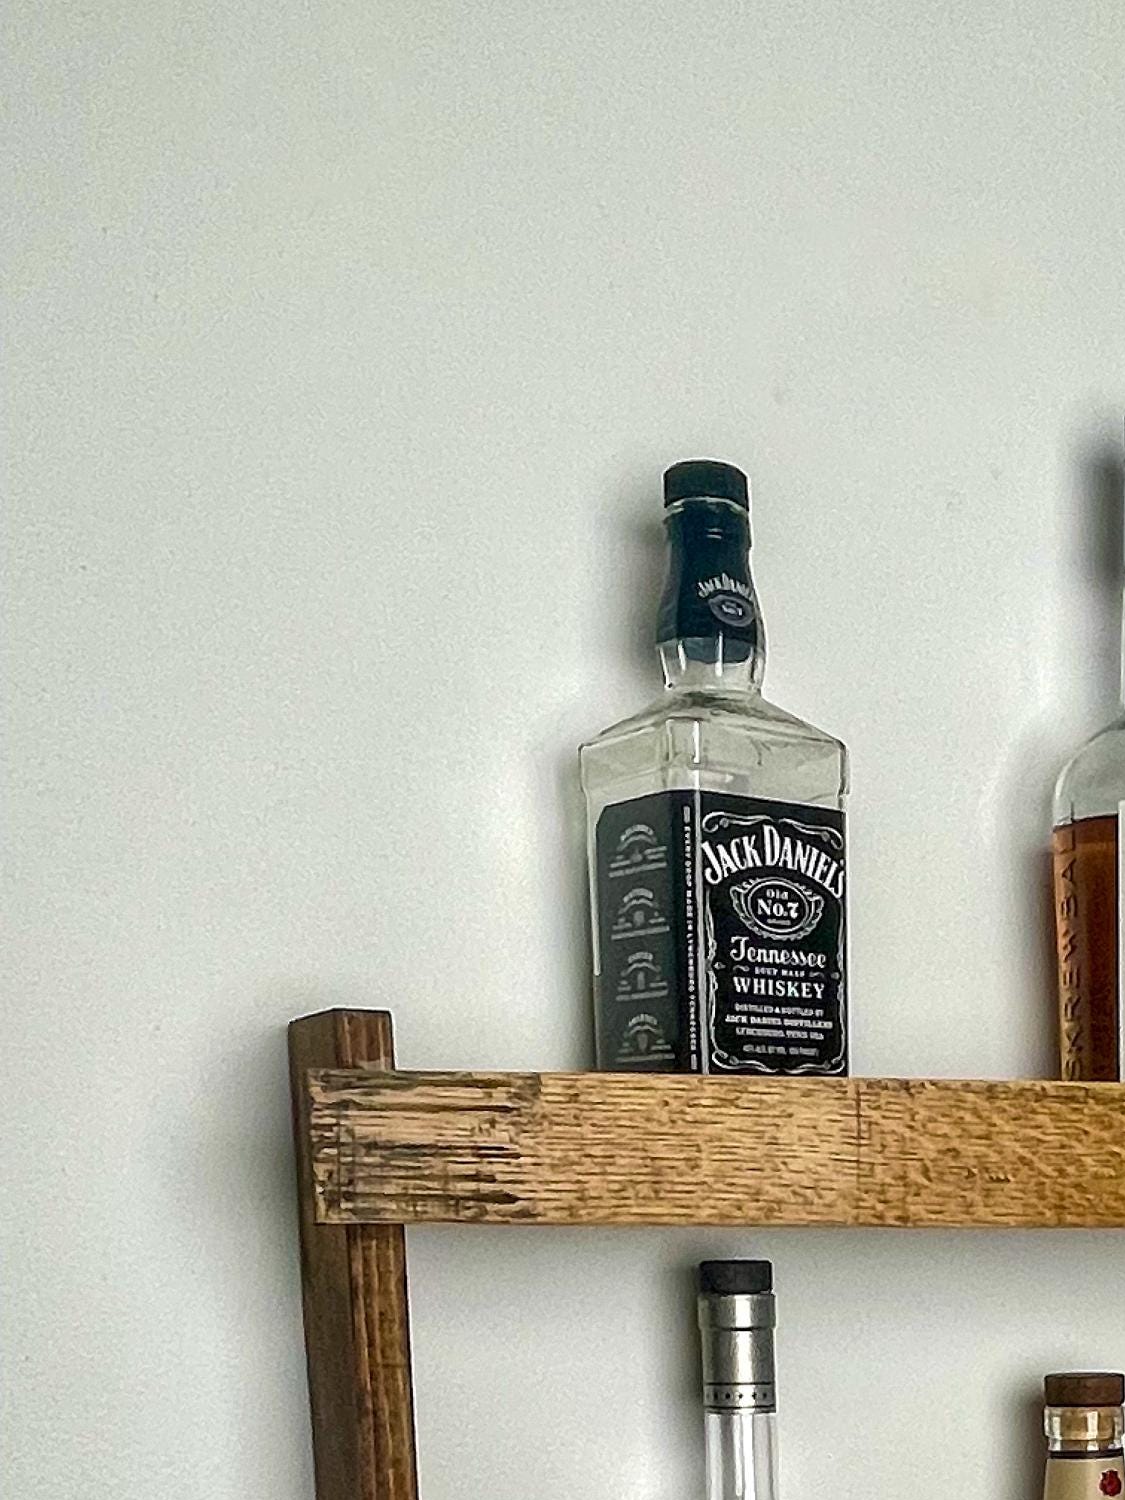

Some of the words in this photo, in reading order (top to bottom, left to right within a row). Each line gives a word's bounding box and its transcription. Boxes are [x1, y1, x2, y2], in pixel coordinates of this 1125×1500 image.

[700, 834, 763, 885] JACK
[762, 824, 845, 899] DANIEL'S
[730, 936, 826, 968] Tennessee
[733, 976, 825, 999] WHISKEY
